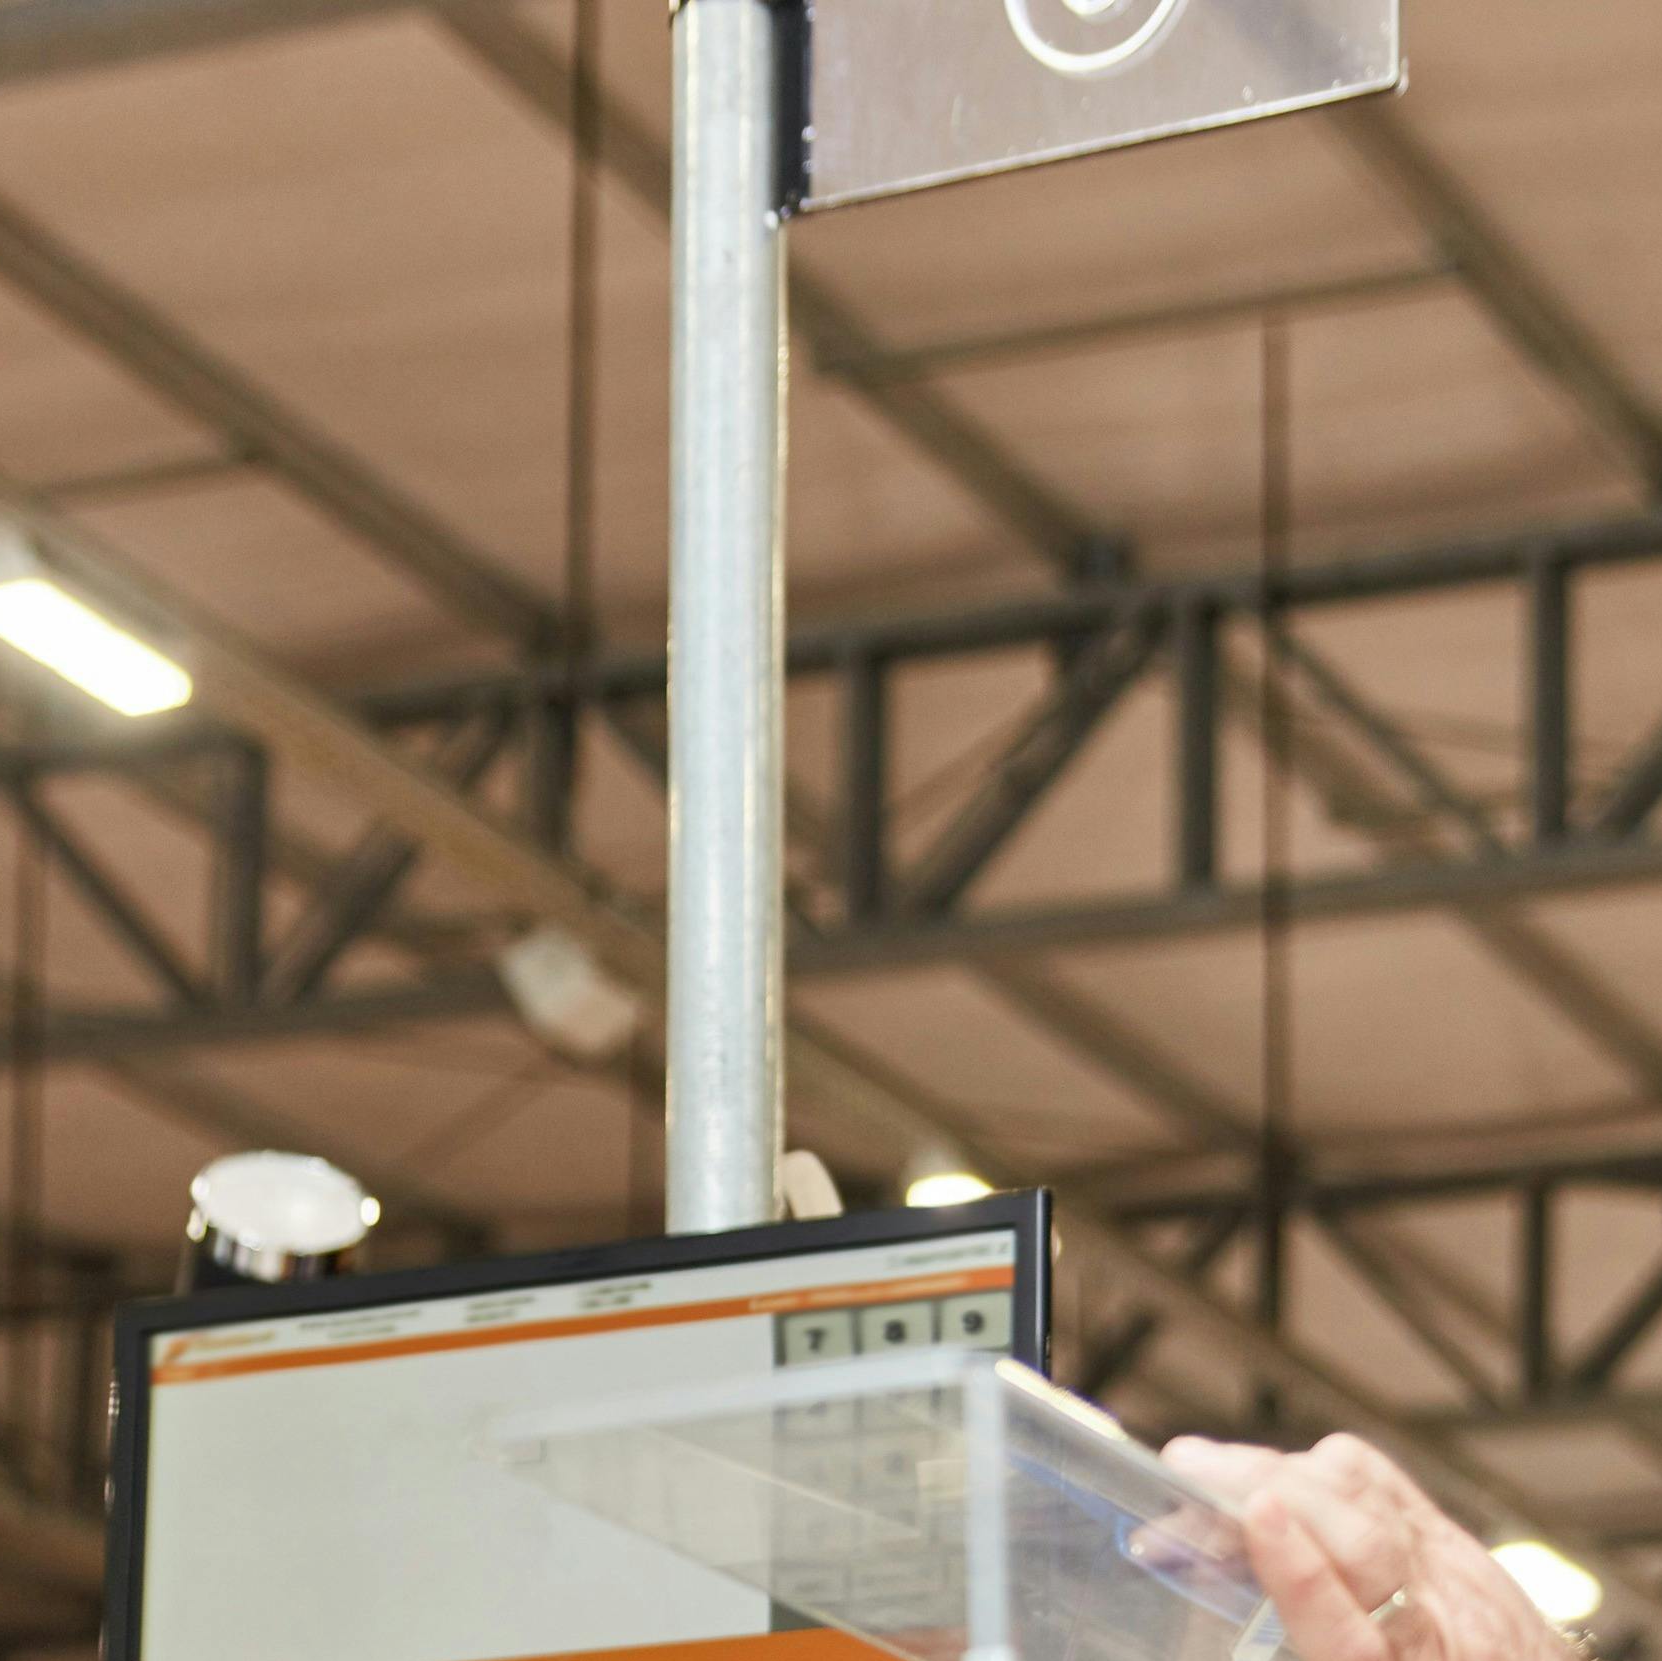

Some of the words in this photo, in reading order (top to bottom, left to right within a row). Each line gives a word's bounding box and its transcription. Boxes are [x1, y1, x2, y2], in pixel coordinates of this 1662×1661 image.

[806, 1327, 826, 1353] 7
[884, 1318, 907, 1344] 8
[961, 1308, 986, 1336] 9
